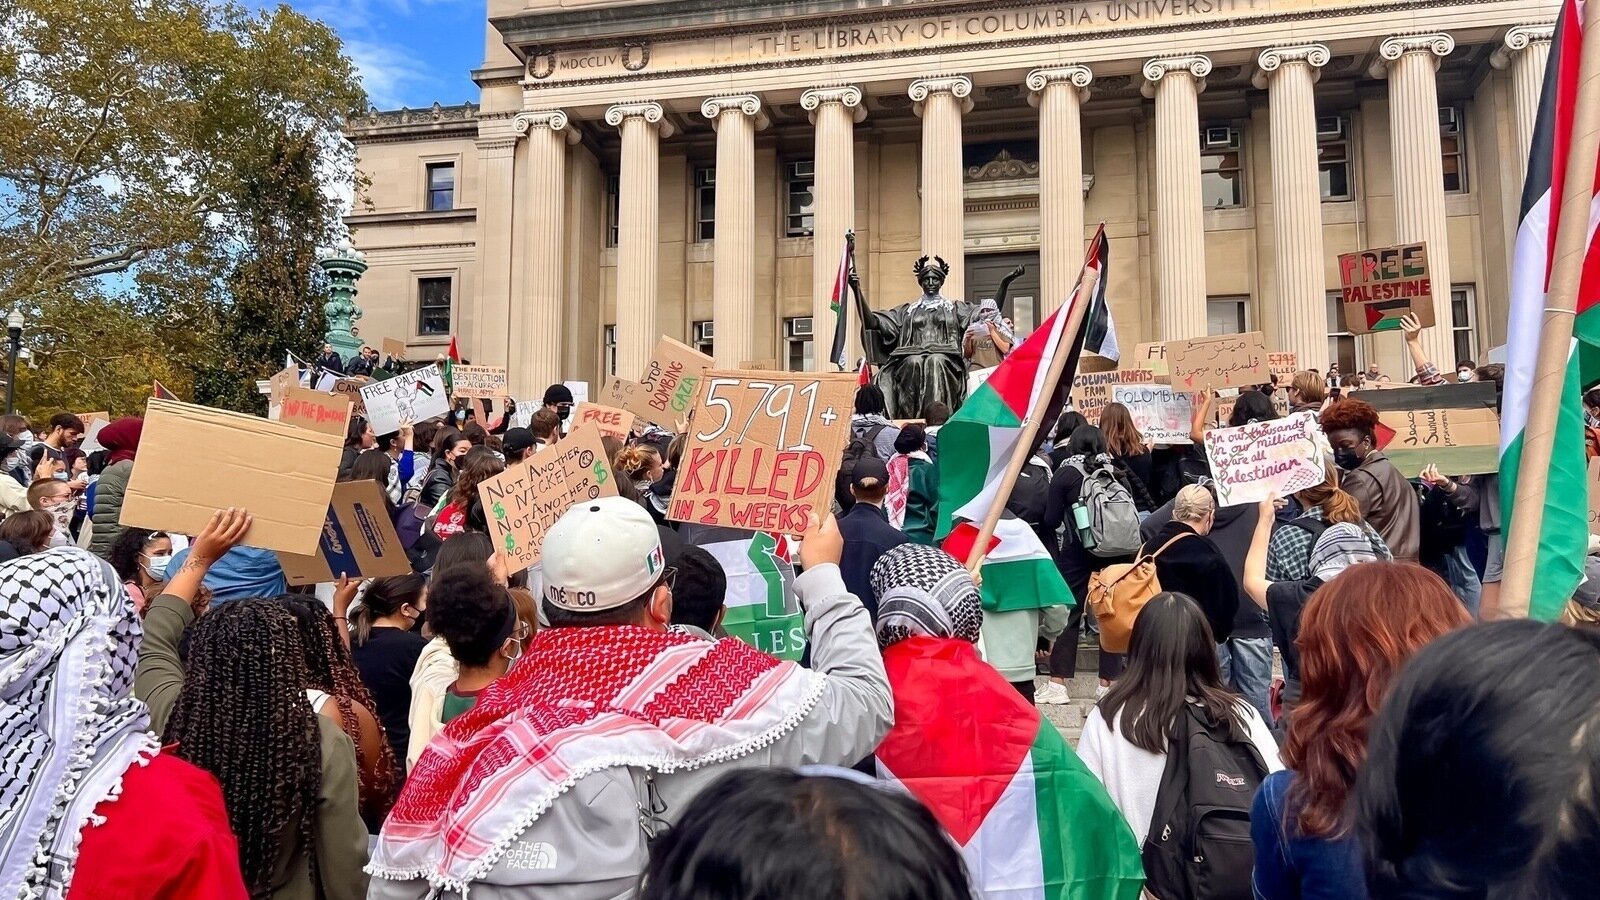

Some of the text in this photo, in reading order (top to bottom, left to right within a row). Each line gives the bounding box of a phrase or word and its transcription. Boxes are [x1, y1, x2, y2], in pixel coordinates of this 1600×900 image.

[759, 36, 800, 55] THE
[814, 23, 910, 50] LIBRARY
[921, 20, 959, 40] OF
[964, 7, 1091, 36] COLUMBIA
[560, 55, 618, 70] MDCCLIV
[1341, 246, 1425, 285] FREE
[1342, 279, 1431, 303] PALESTINE
[364, 366, 440, 399] FREE PALESTINE
[453, 373, 505, 383] DESTRUCTION
[640, 360, 662, 393] STOP
[648, 360, 683, 411] BOMBING
[1073, 372, 1120, 387] COLUMBIA
[671, 376, 699, 412] GAZA
[1084, 385, 1106, 397] FROM
[1115, 390, 1187, 404] COLUMBIA
[695, 378, 838, 452] 5,791+
[1079, 397, 1108, 410] BOEING
[583, 409, 622, 425] FREE
[1420, 409, 1439, 444] Sumud
[1213, 420, 1305, 444] in our thousands
[1214, 432, 1306, 455] in our millions
[530, 446, 580, 482] ANOTHER
[1215, 450, 1267, 468] we are all
[1220, 458, 1301, 484] Palestinian
[681, 447, 825, 500] KILLED
[515, 466, 575, 511] NICKEL
[532, 478, 589, 519] ANOTHER
[672, 498, 813, 532] IN 2 WEEKS
[507, 547, 522, 558] NO
[519, 549, 541, 563] FOR
[505, 849, 540, 860] ORTH
[518, 841, 541, 851] THE
[506, 859, 537, 869] FACE
